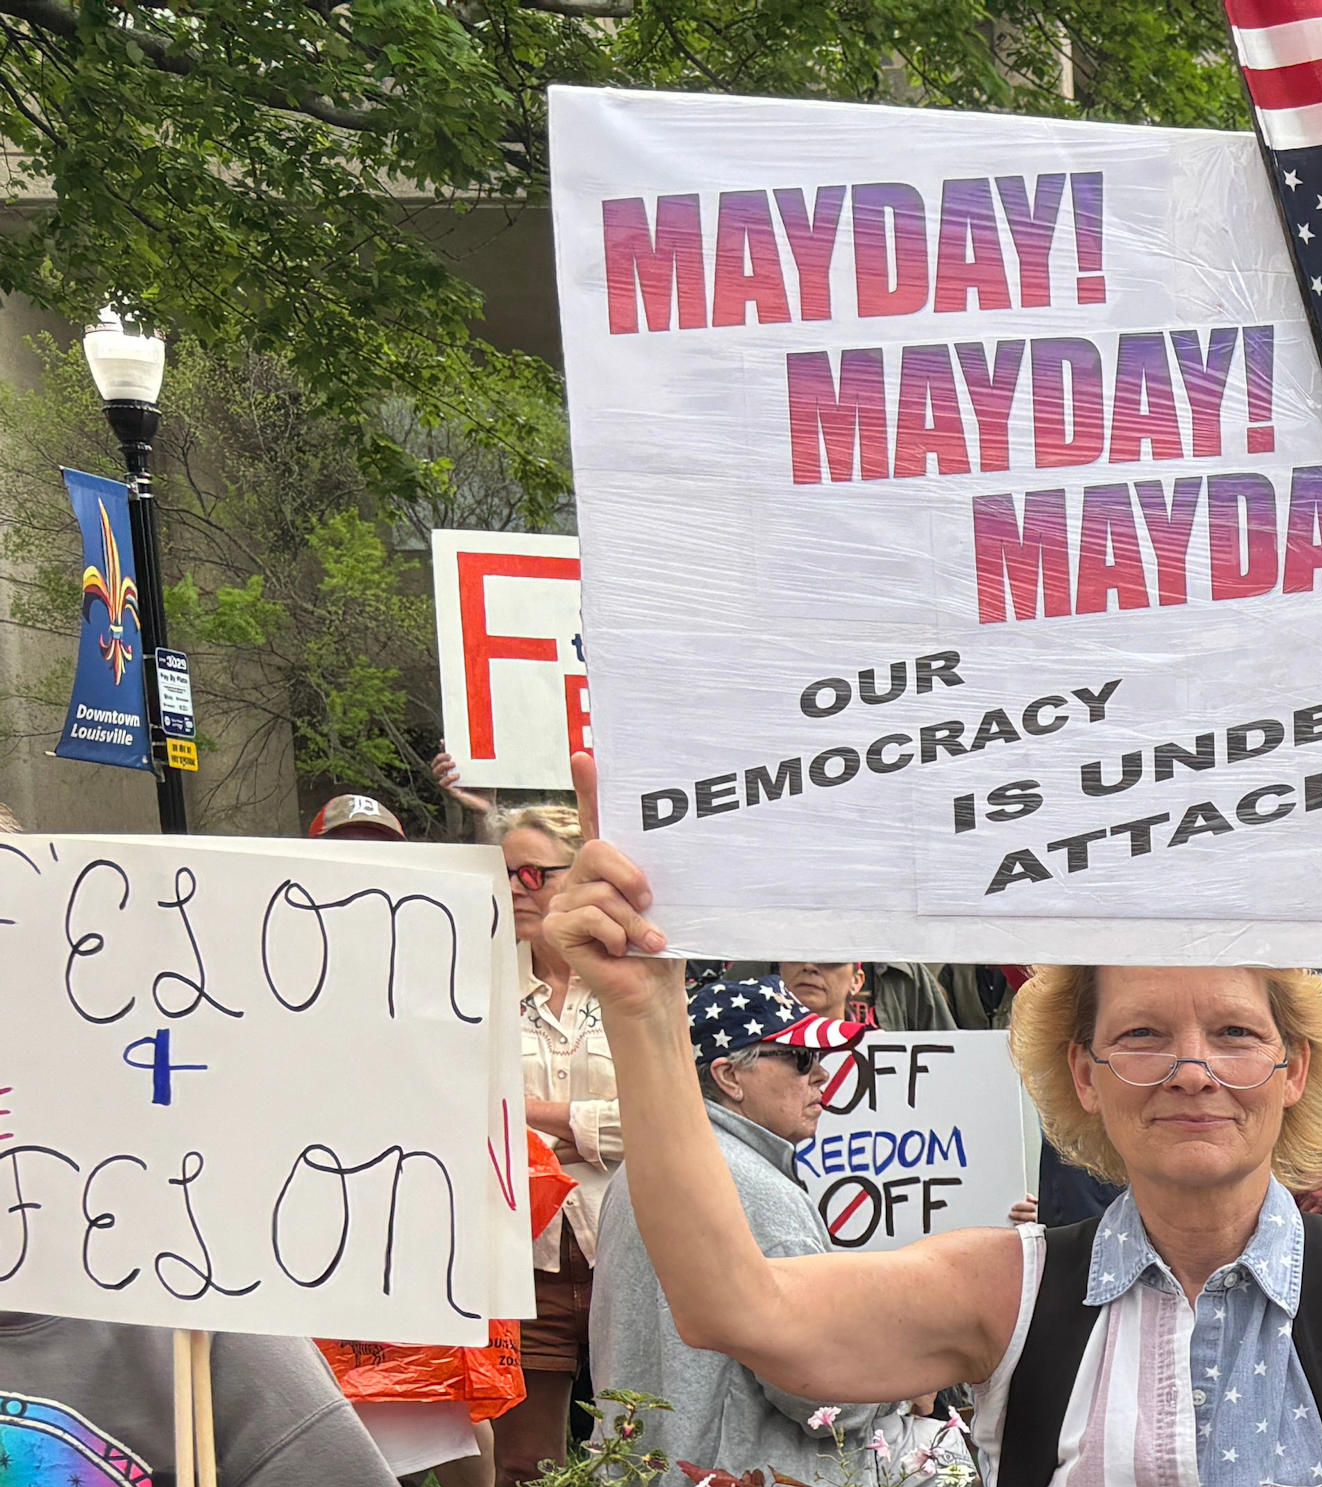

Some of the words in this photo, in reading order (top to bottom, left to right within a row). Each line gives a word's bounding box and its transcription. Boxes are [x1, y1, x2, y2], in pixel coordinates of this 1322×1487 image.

[602, 171, 1107, 335] MAYDAY!
[786, 325, 1276, 486] MAYDAY!
[76, 703, 141, 727] Downtown
[799, 649, 965, 720] OUR
[70, 723, 134, 746] Louisville
[640, 679, 1124, 833] DEMOCRACY
[953, 778, 1045, 836] IS
[818, 1174, 963, 1249] OFF
